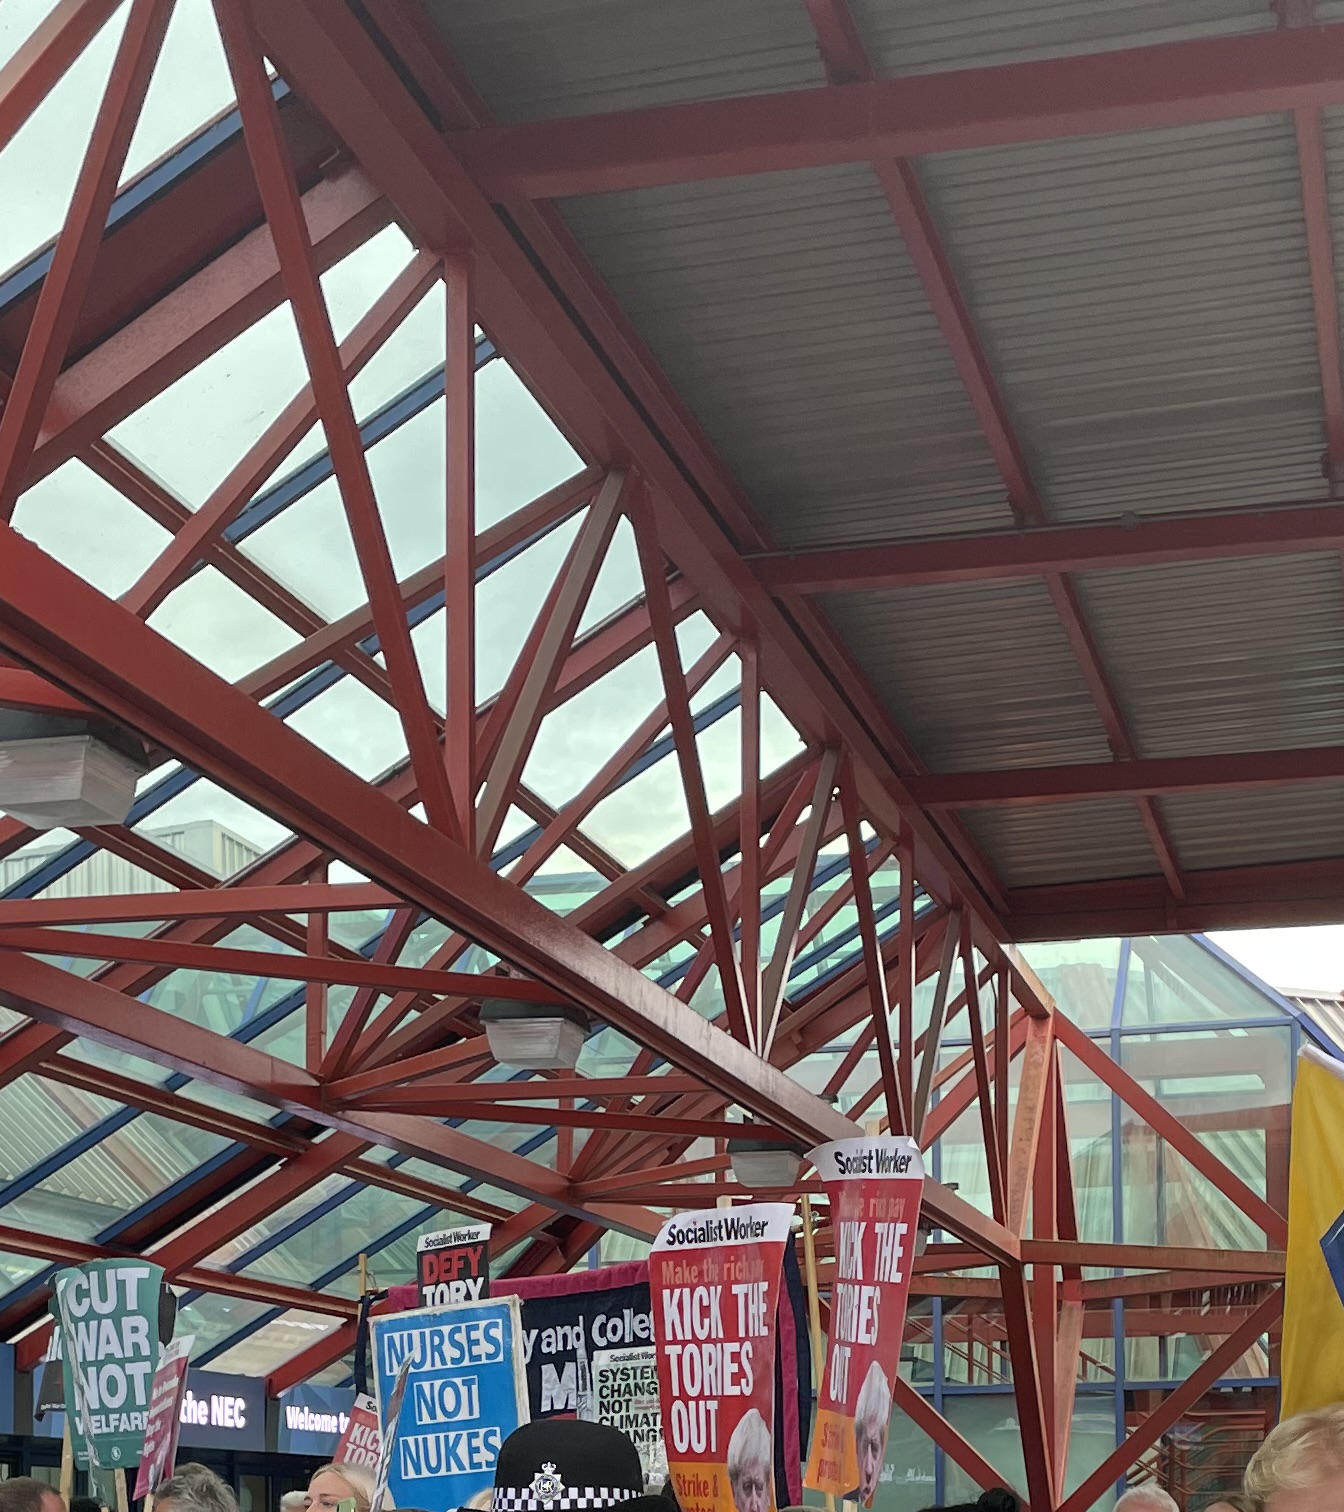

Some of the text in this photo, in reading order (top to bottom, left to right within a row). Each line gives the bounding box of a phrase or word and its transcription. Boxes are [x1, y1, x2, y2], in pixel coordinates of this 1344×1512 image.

[424, 1229, 481, 1249] Socialist Worker
[666, 1215, 769, 1247] Socialist Worker
[422, 1245, 484, 1283] DEFY
[661, 1260, 700, 1286] Make
[874, 1222, 907, 1284] THE
[66, 1267, 151, 1318] CUT
[422, 1276, 485, 1308] TORY
[662, 1281, 769, 1341] KICK THE
[71, 1315, 151, 1363] WAR
[387, 1320, 502, 1373] NURSES
[541, 1315, 584, 1355] and
[74, 1361, 152, 1411] NOT
[664, 1340, 754, 1397] TORIES
[180, 1390, 209, 1426] the
[211, 1394, 246, 1429] NEC
[416, 1376, 478, 1422] NOT
[598, 1380, 659, 1400] CHANG
[598, 1399, 633, 1416] NOT
[286, 1406, 338, 1434] Welcome
[670, 1398, 719, 1454] OUT
[401, 1428, 499, 1478] NUKES
[675, 1473, 719, 1498] Strike &
